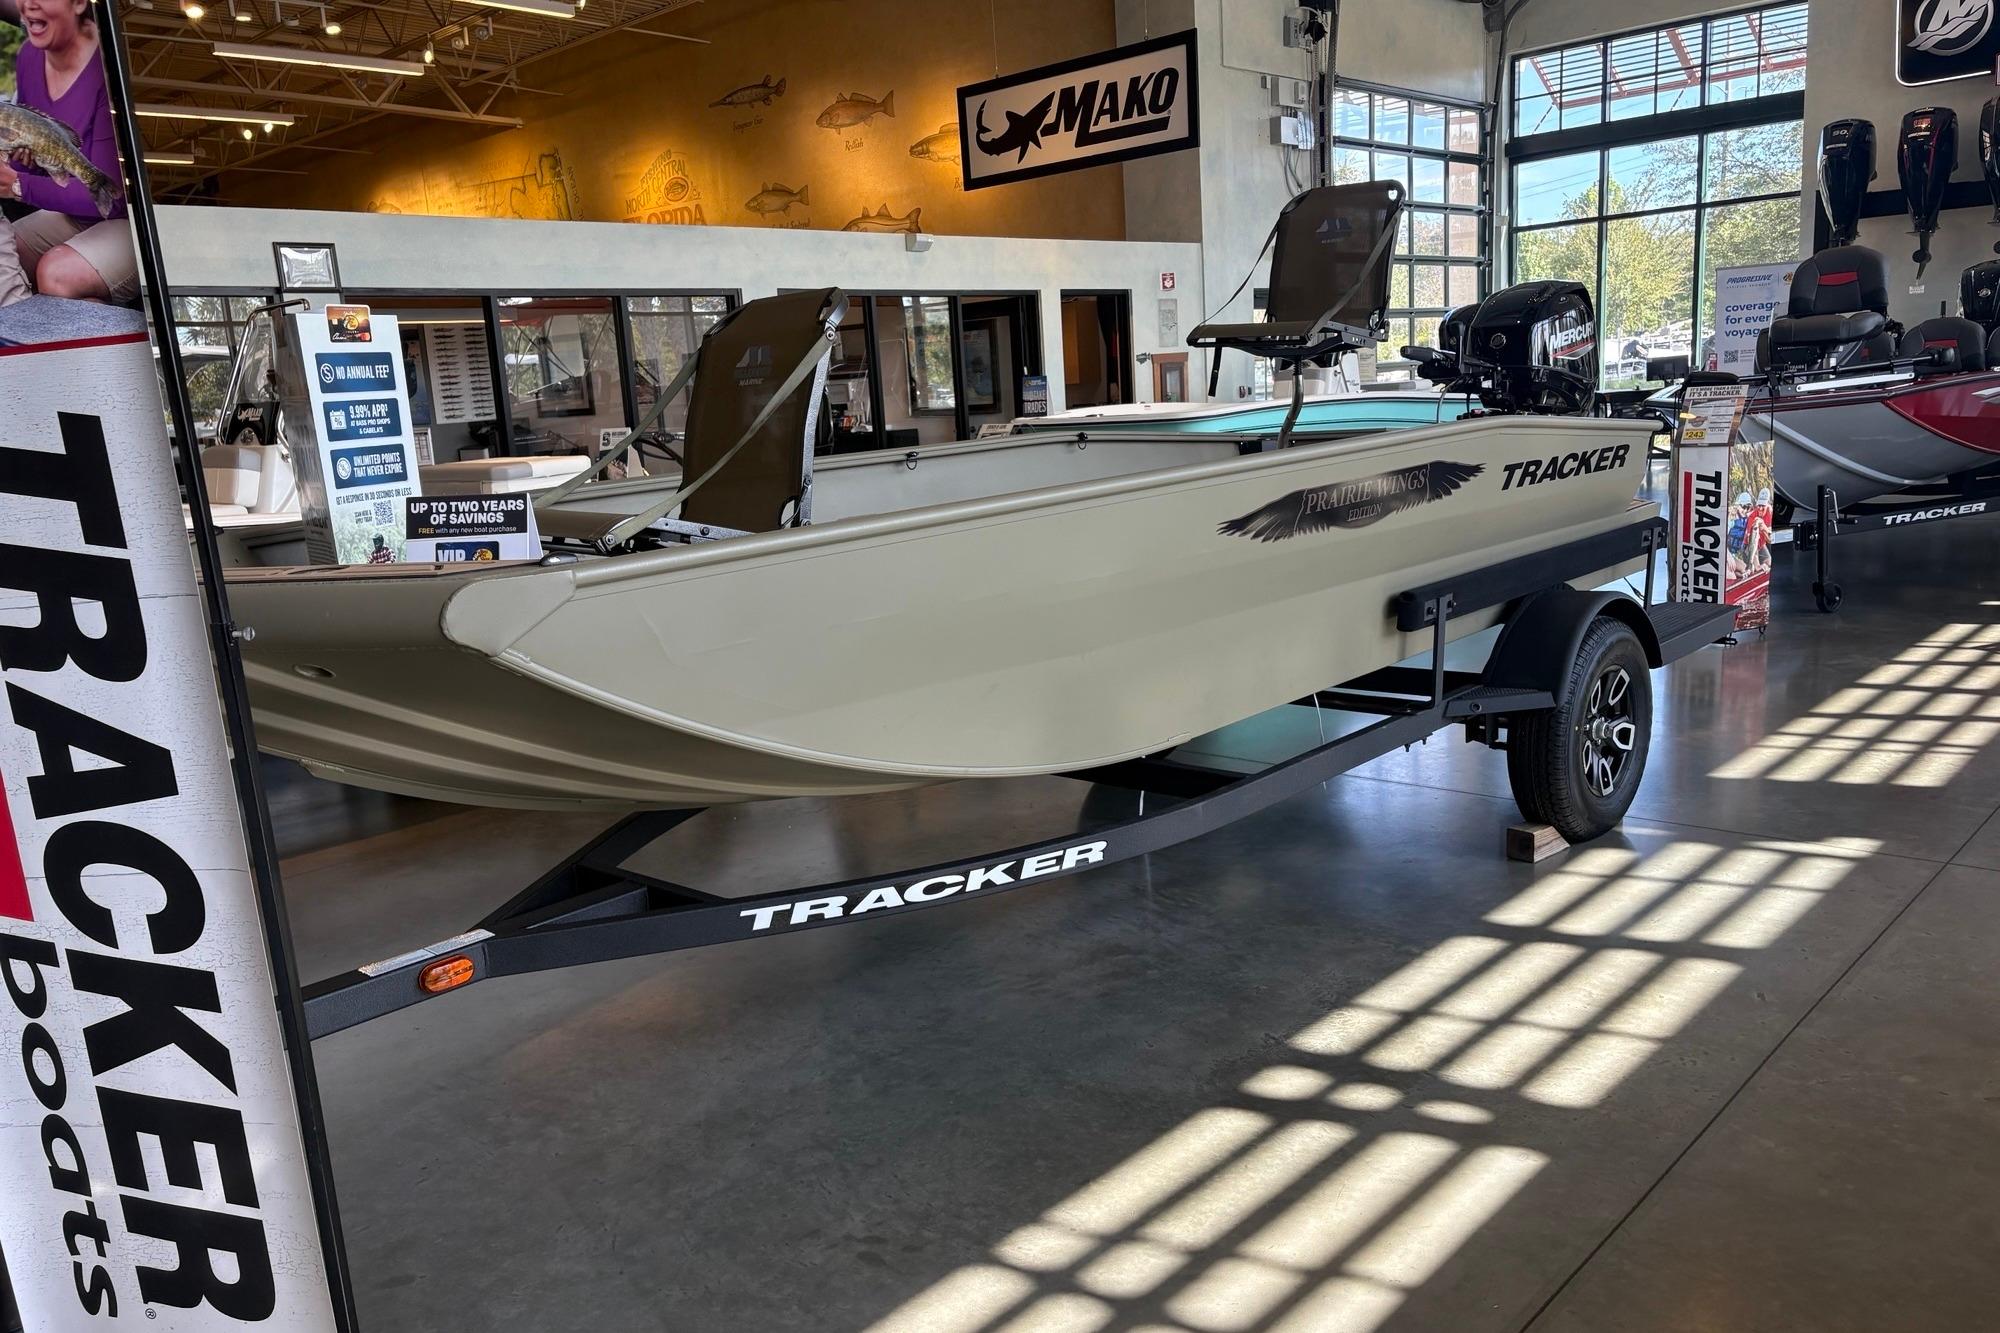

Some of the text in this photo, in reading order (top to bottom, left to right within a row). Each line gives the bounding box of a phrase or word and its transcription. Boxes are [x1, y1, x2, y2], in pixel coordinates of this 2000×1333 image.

[1040, 67, 1180, 148] MAKO
[625, 159, 689, 215] NORTH CENTRAL
[1726, 273, 1773, 284] PROGRESSIVE
[1725, 315, 1771, 325] for ever
[1725, 328, 1761, 339] voyag
[336, 366, 346, 380] NO
[346, 365, 375, 379] ANNUAL
[349, 404, 371, 419] 9.99%
[1023, 401, 1047, 414] TRADES
[353, 452, 401, 466] UNLIMITED POINTS
[353, 463, 404, 478] THAT NEVER EXPIRE
[1502, 444, 1631, 491] TRACKER
[376, 490, 394, 499] SECONDS
[401, 487, 412, 496] LESS
[1304, 468, 1428, 515] PRAIRIE WINGS
[410, 499, 525, 513] UP TO TWO YEARS
[1347, 503, 1383, 522] EDITION
[430, 512, 504, 525] OF SAVINGS
[1883, 502, 1987, 527] TRACKER
[488, 526, 517, 534] purchase
[1693, 471, 1722, 604] TRACKER
[437, 549, 466, 562] VIP
[0, 412, 276, 1321] TRACKER
[740, 839, 1108, 933] TRACKER
[0, 934, 118, 1318] boats
